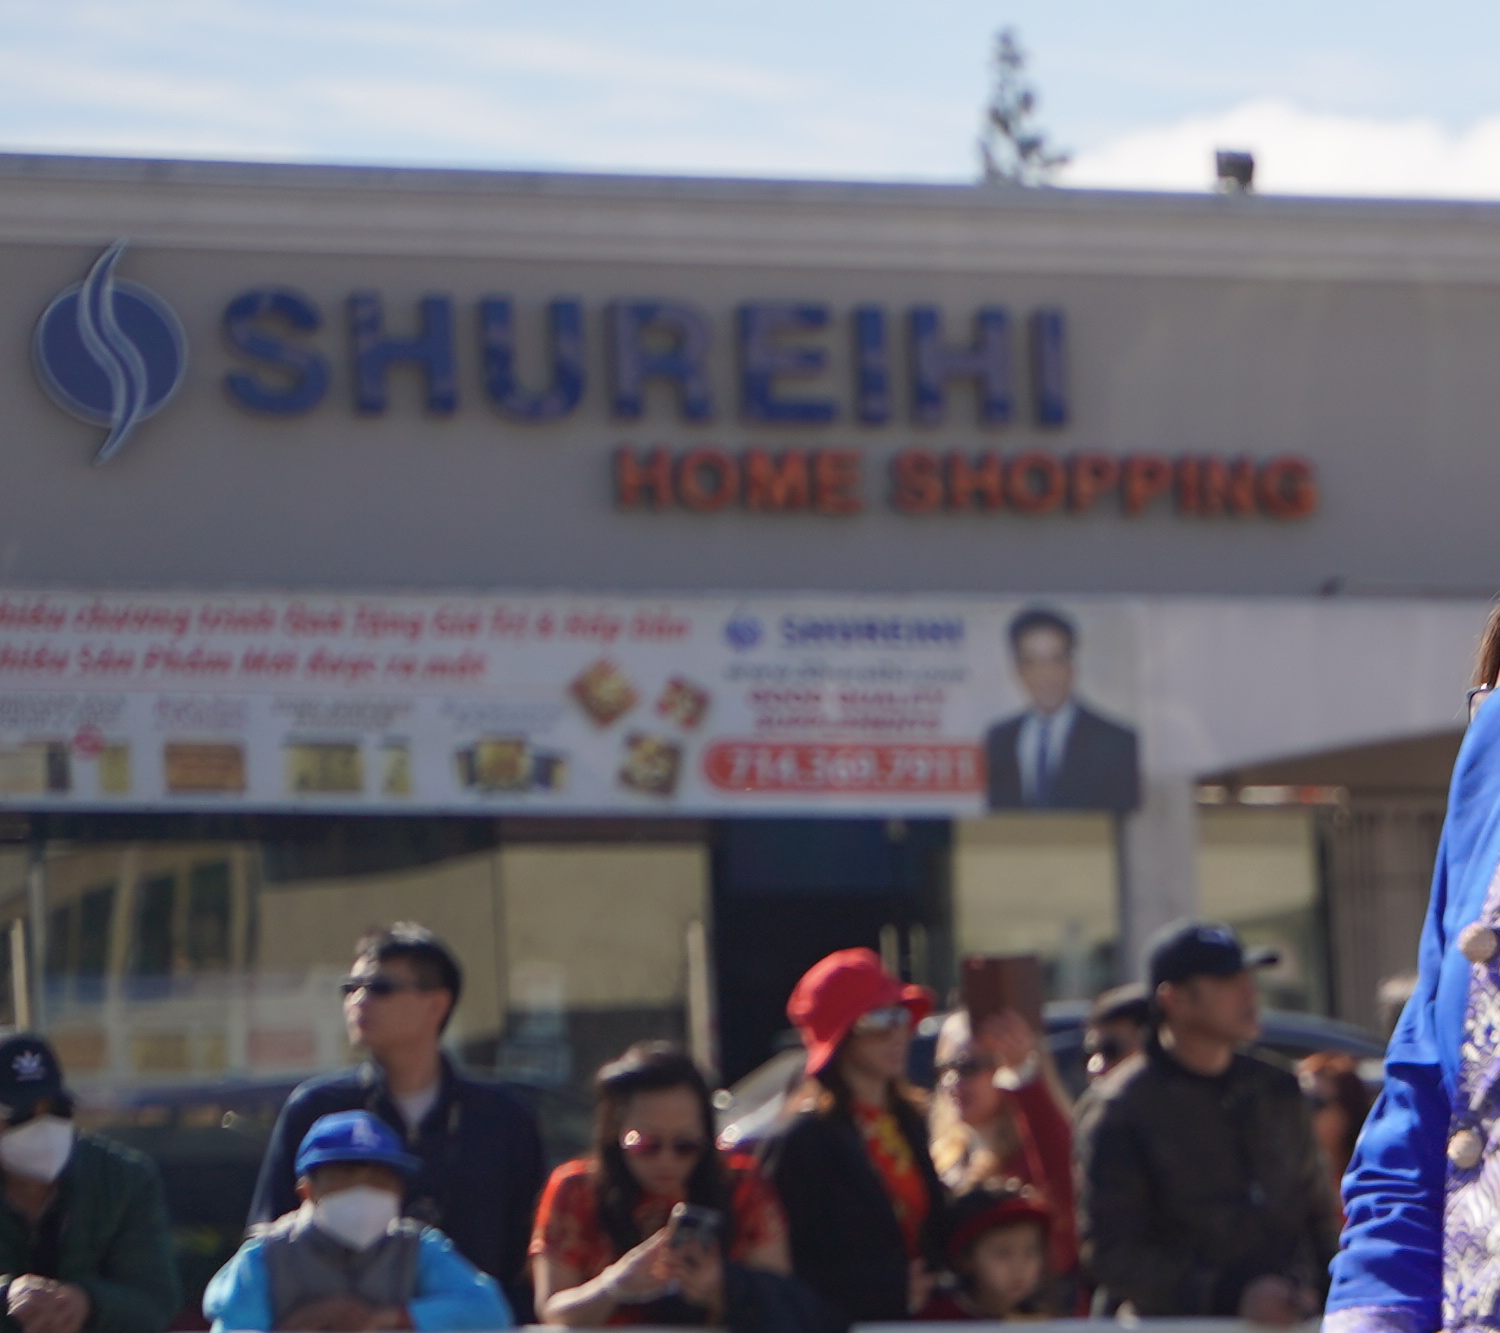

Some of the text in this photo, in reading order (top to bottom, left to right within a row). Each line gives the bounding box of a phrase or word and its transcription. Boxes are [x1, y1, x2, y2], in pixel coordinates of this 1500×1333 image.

[221, 284, 1072, 430] SHUREIHI
[613, 441, 1322, 523] HOME SHOPPING
